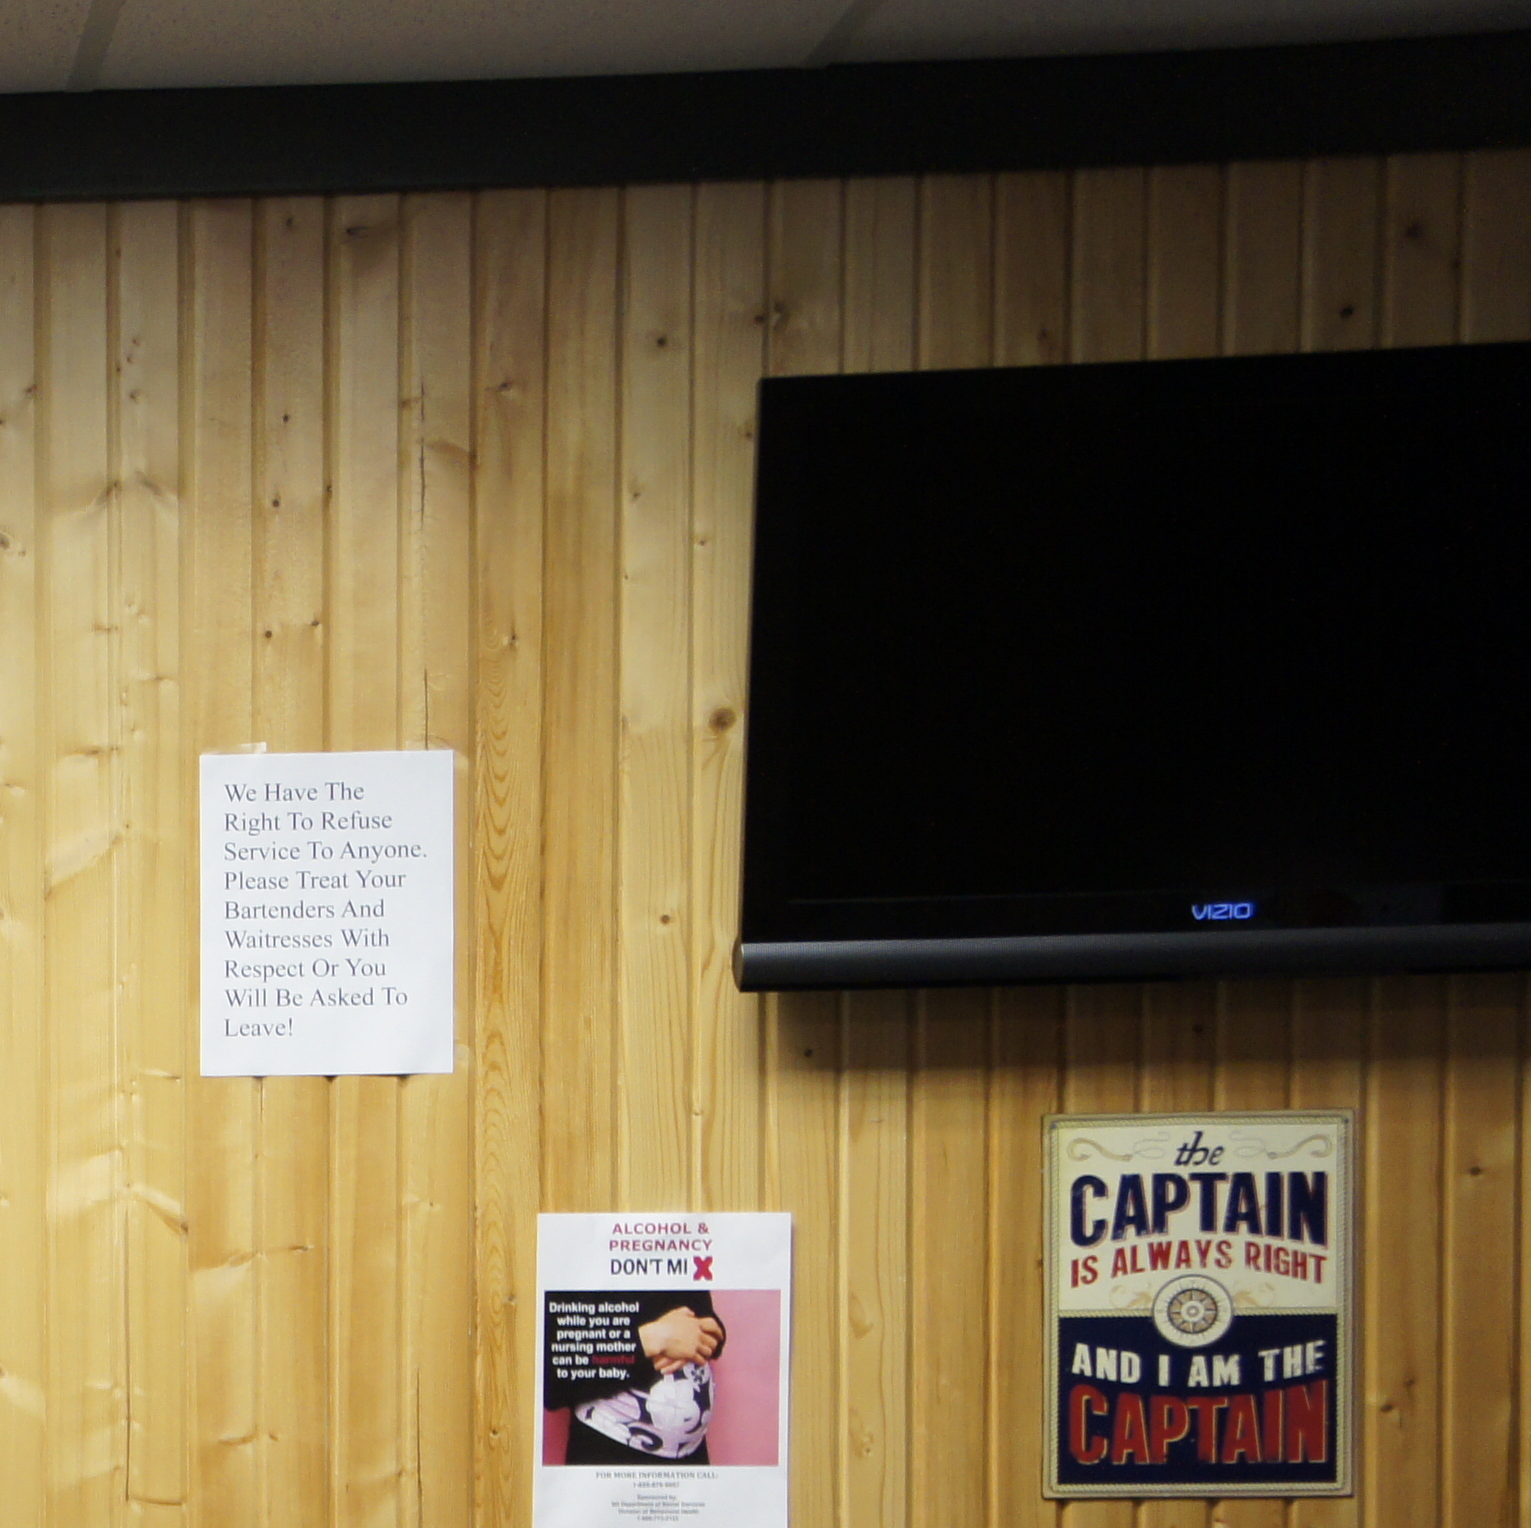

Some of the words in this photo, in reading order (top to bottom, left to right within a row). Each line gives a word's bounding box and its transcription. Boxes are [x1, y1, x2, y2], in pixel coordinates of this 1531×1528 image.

[224, 783, 257, 802] We
[264, 782, 318, 801] Have
[324, 781, 365, 801] The
[224, 811, 280, 836] Right
[287, 811, 313, 831] To
[321, 810, 393, 830] Refuse
[224, 841, 300, 861] Service
[307, 841, 333, 860] To
[340, 840, 427, 864] Anyone.
[224, 871, 289, 890] Please
[295, 870, 349, 889] Treat
[356, 869, 406, 888] Your
[224, 900, 335, 919] Bartenders
[341, 898, 385, 918] And
[1191, 902, 1252, 920] VIZIO
[224, 930, 333, 949] Waitresses
[341, 928, 389, 947] With
[224, 959, 305, 983] Respect
[312, 958, 339, 978] Or
[346, 958, 386, 977] You
[224, 988, 267, 1007] Will
[276, 988, 303, 1006] Be
[310, 987, 374, 1006] Asked
[381, 987, 408, 1005] To
[224, 1018, 293, 1037] Leave!
[1174, 1131, 1224, 1167] the
[1070, 1171, 1328, 1248] CAPTAIN
[612, 1222, 692, 1236] ALCOHOL
[697, 1222, 710, 1236] &
[609, 1239, 712, 1252] PREGNANCY
[610, 1258, 662, 1276] DON'T
[1071, 1255, 1099, 1288] IS
[1111, 1240, 1233, 1278] ALWAYS
[1244, 1241, 1328, 1285] RIGHT
[549, 1301, 595, 1315] Drinking
[598, 1301, 639, 1313] alcohol
[557, 1315, 586, 1326] while
[589, 1317, 610, 1329] you
[613, 1317, 630, 1326] are
[556, 1329, 606, 1342] pregnant
[609, 1330, 621, 1340] or
[623, 1330, 631, 1340] a
[551, 1342, 593, 1355] nursing
[596, 1341, 637, 1352] mother
[552, 1355, 572, 1366] can
[575, 1354, 590, 1366] be
[1072, 1343, 1141, 1384] AND
[1158, 1355, 1170, 1387] I
[1188, 1355, 1242, 1388] AM
[1258, 1340, 1326, 1382] THE
[557, 1368, 569, 1378] to
[570, 1369, 597, 1381] your
[599, 1367, 631, 1380] baby.
[1069, 1380, 1328, 1465] CAPTAIN
